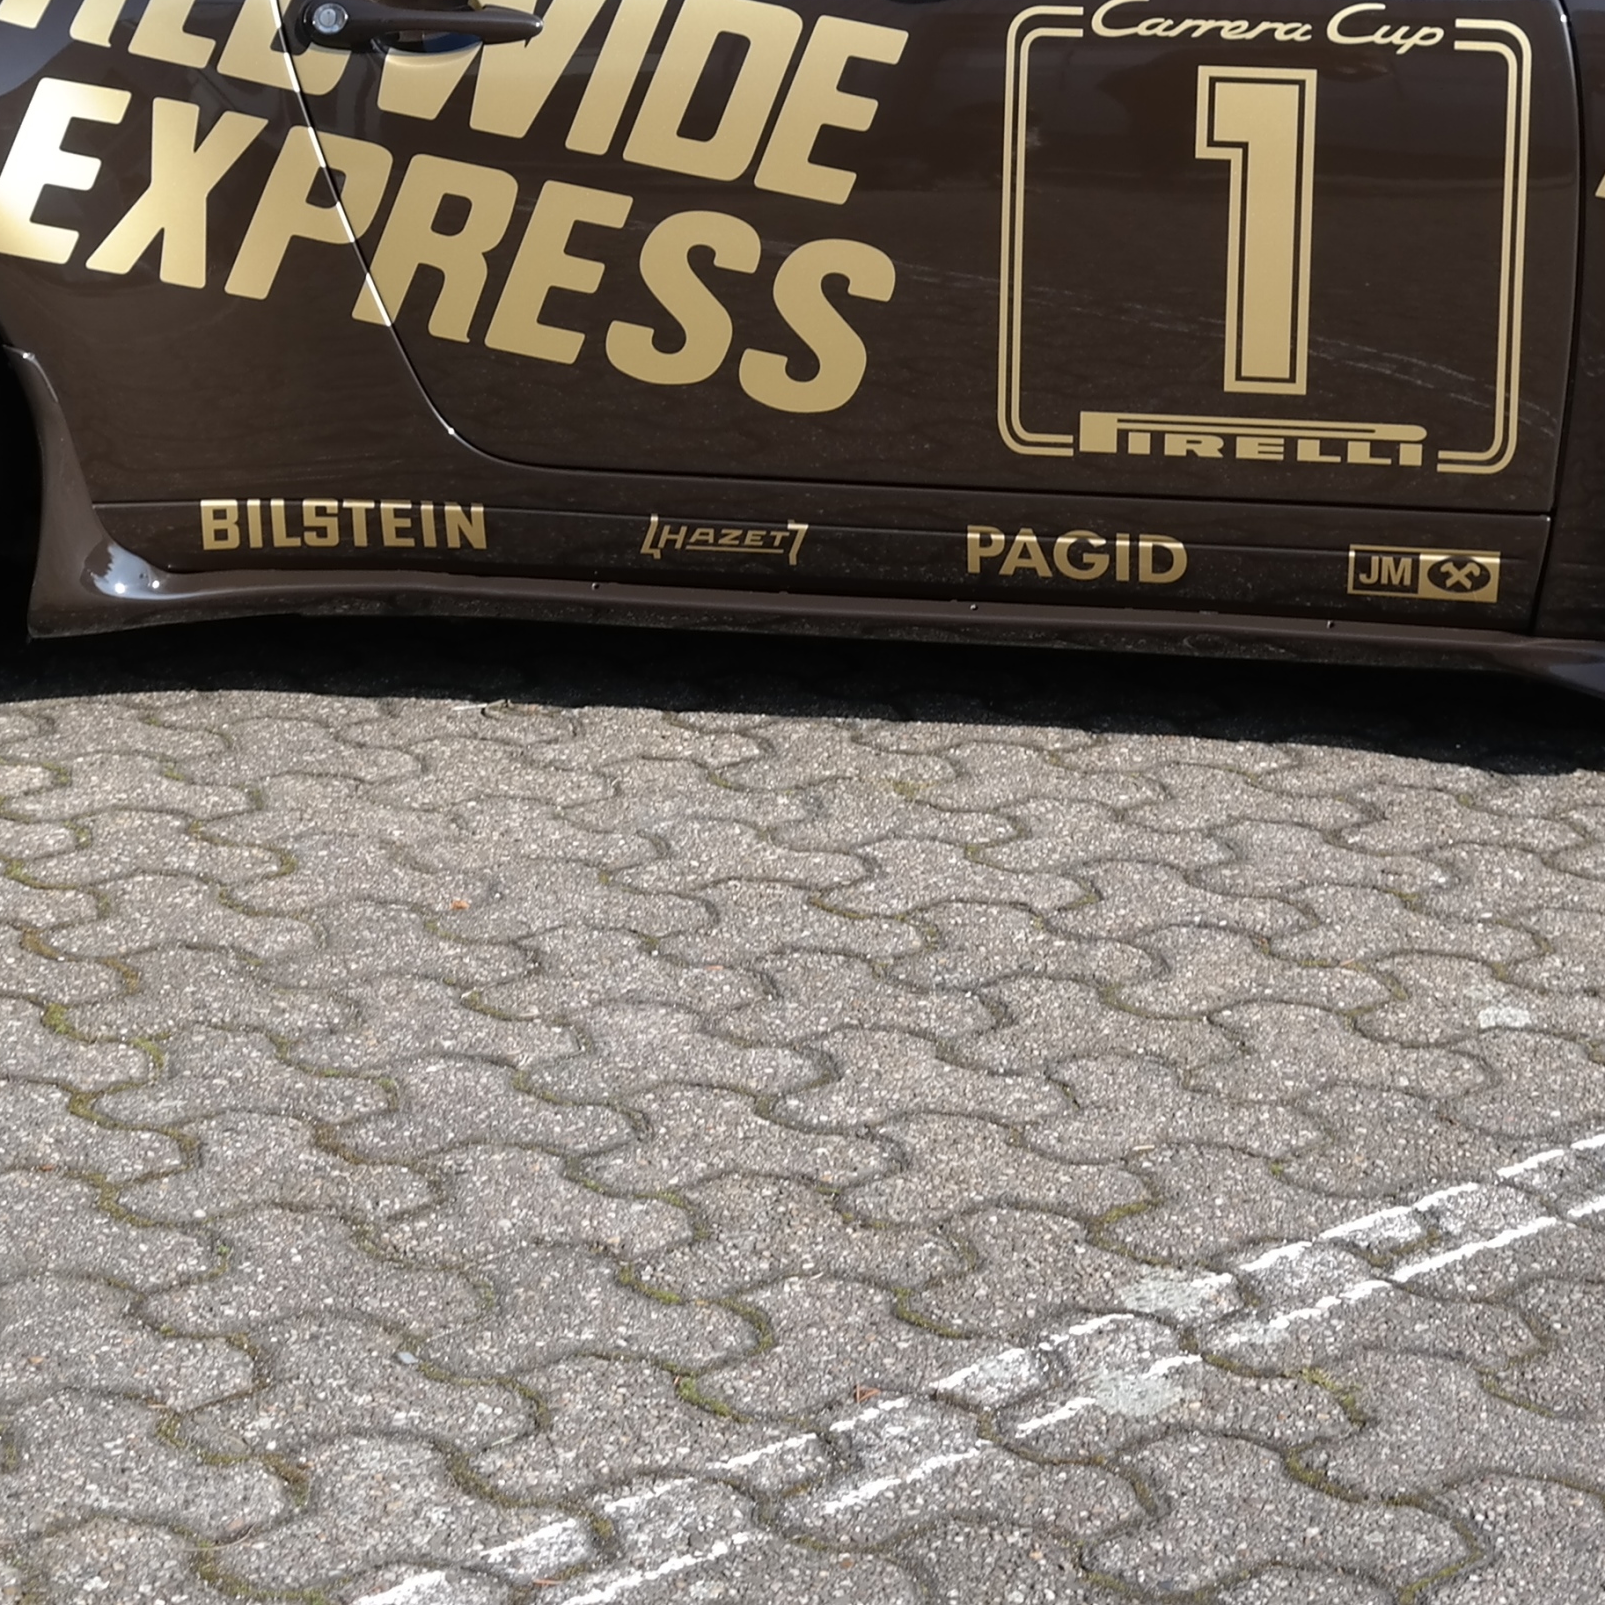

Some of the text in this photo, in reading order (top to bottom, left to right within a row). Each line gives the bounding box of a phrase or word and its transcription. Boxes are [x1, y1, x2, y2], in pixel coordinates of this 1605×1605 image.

[1326, 2, 1445, 55] Cup
[1195, 65, 1317, 395] 1
[1079, 411, 1427, 466] PIRELLI
[199, 500, 487, 549] BILSTEIN
[655, 522, 793, 555] HAZET
[965, 525, 1188, 584] PAGID
[1358, 555, 1413, 587] JM
